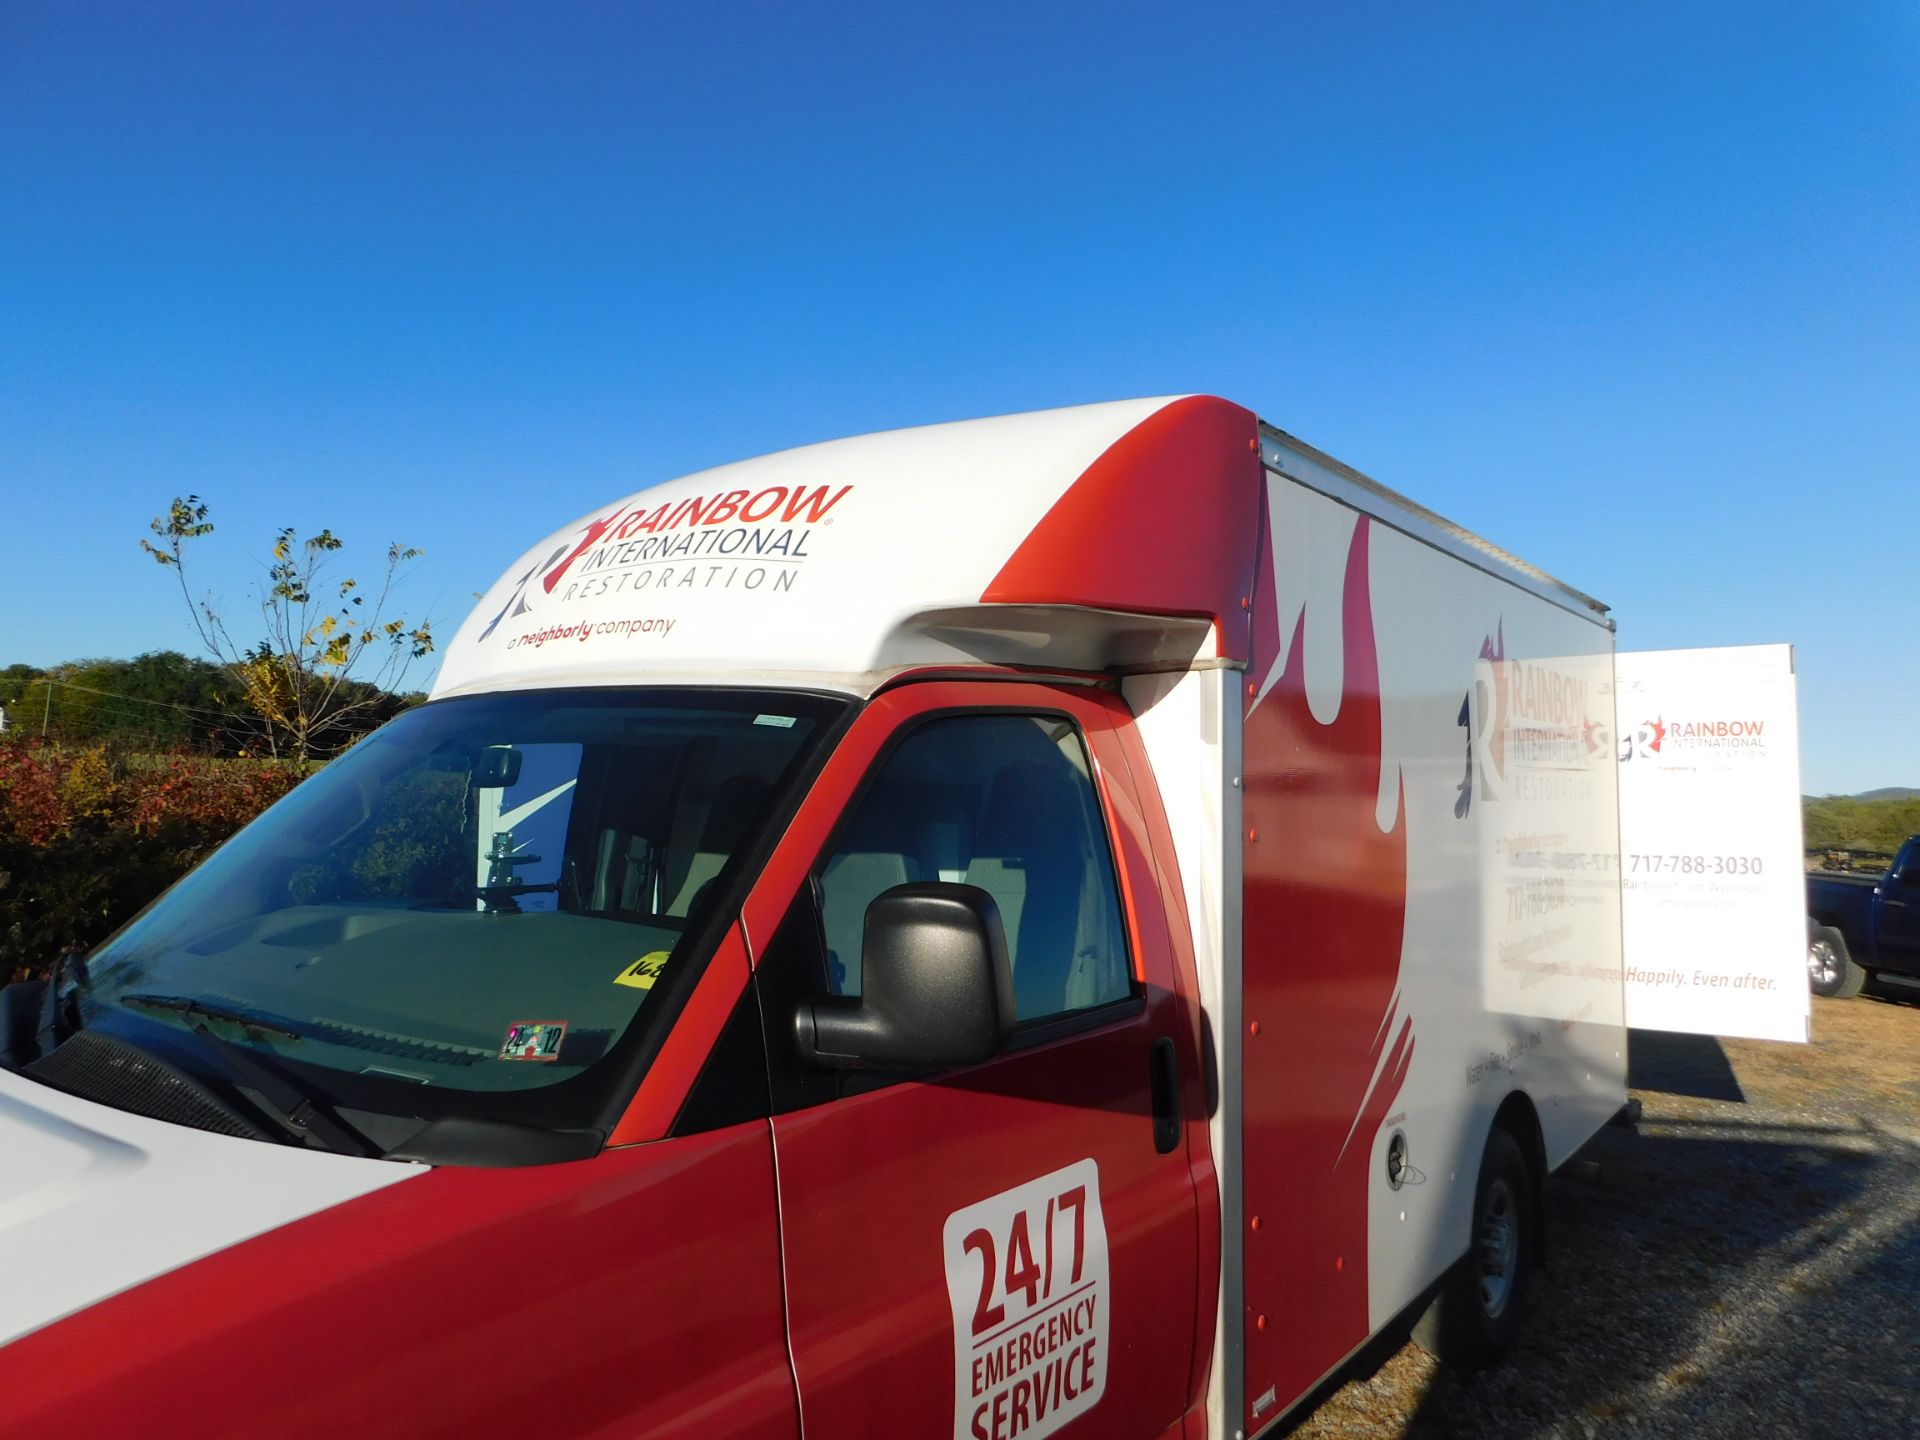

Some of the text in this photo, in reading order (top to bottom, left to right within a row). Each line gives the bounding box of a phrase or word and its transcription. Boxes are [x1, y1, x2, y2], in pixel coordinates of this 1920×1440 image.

[603, 484, 854, 543] RAINBOW
[580, 527, 813, 573] INTERNATIONAL
[561, 565, 799, 602] RESTORATION
[507, 617, 677, 650] a neighborly company
[1670, 720, 1765, 738] RAINBOW
[1629, 854, 1763, 875] 717-788-3030
[1625, 966, 1688, 989] Happily.
[1692, 970, 1729, 988] Even
[1733, 972, 1777, 991] after.
[543, 1027, 562, 1053] 12
[963, 1184, 1086, 1337] 24/7
[971, 1293, 1097, 1399] EMERGENCY
[970, 1336, 1097, 1440] SERVICE
